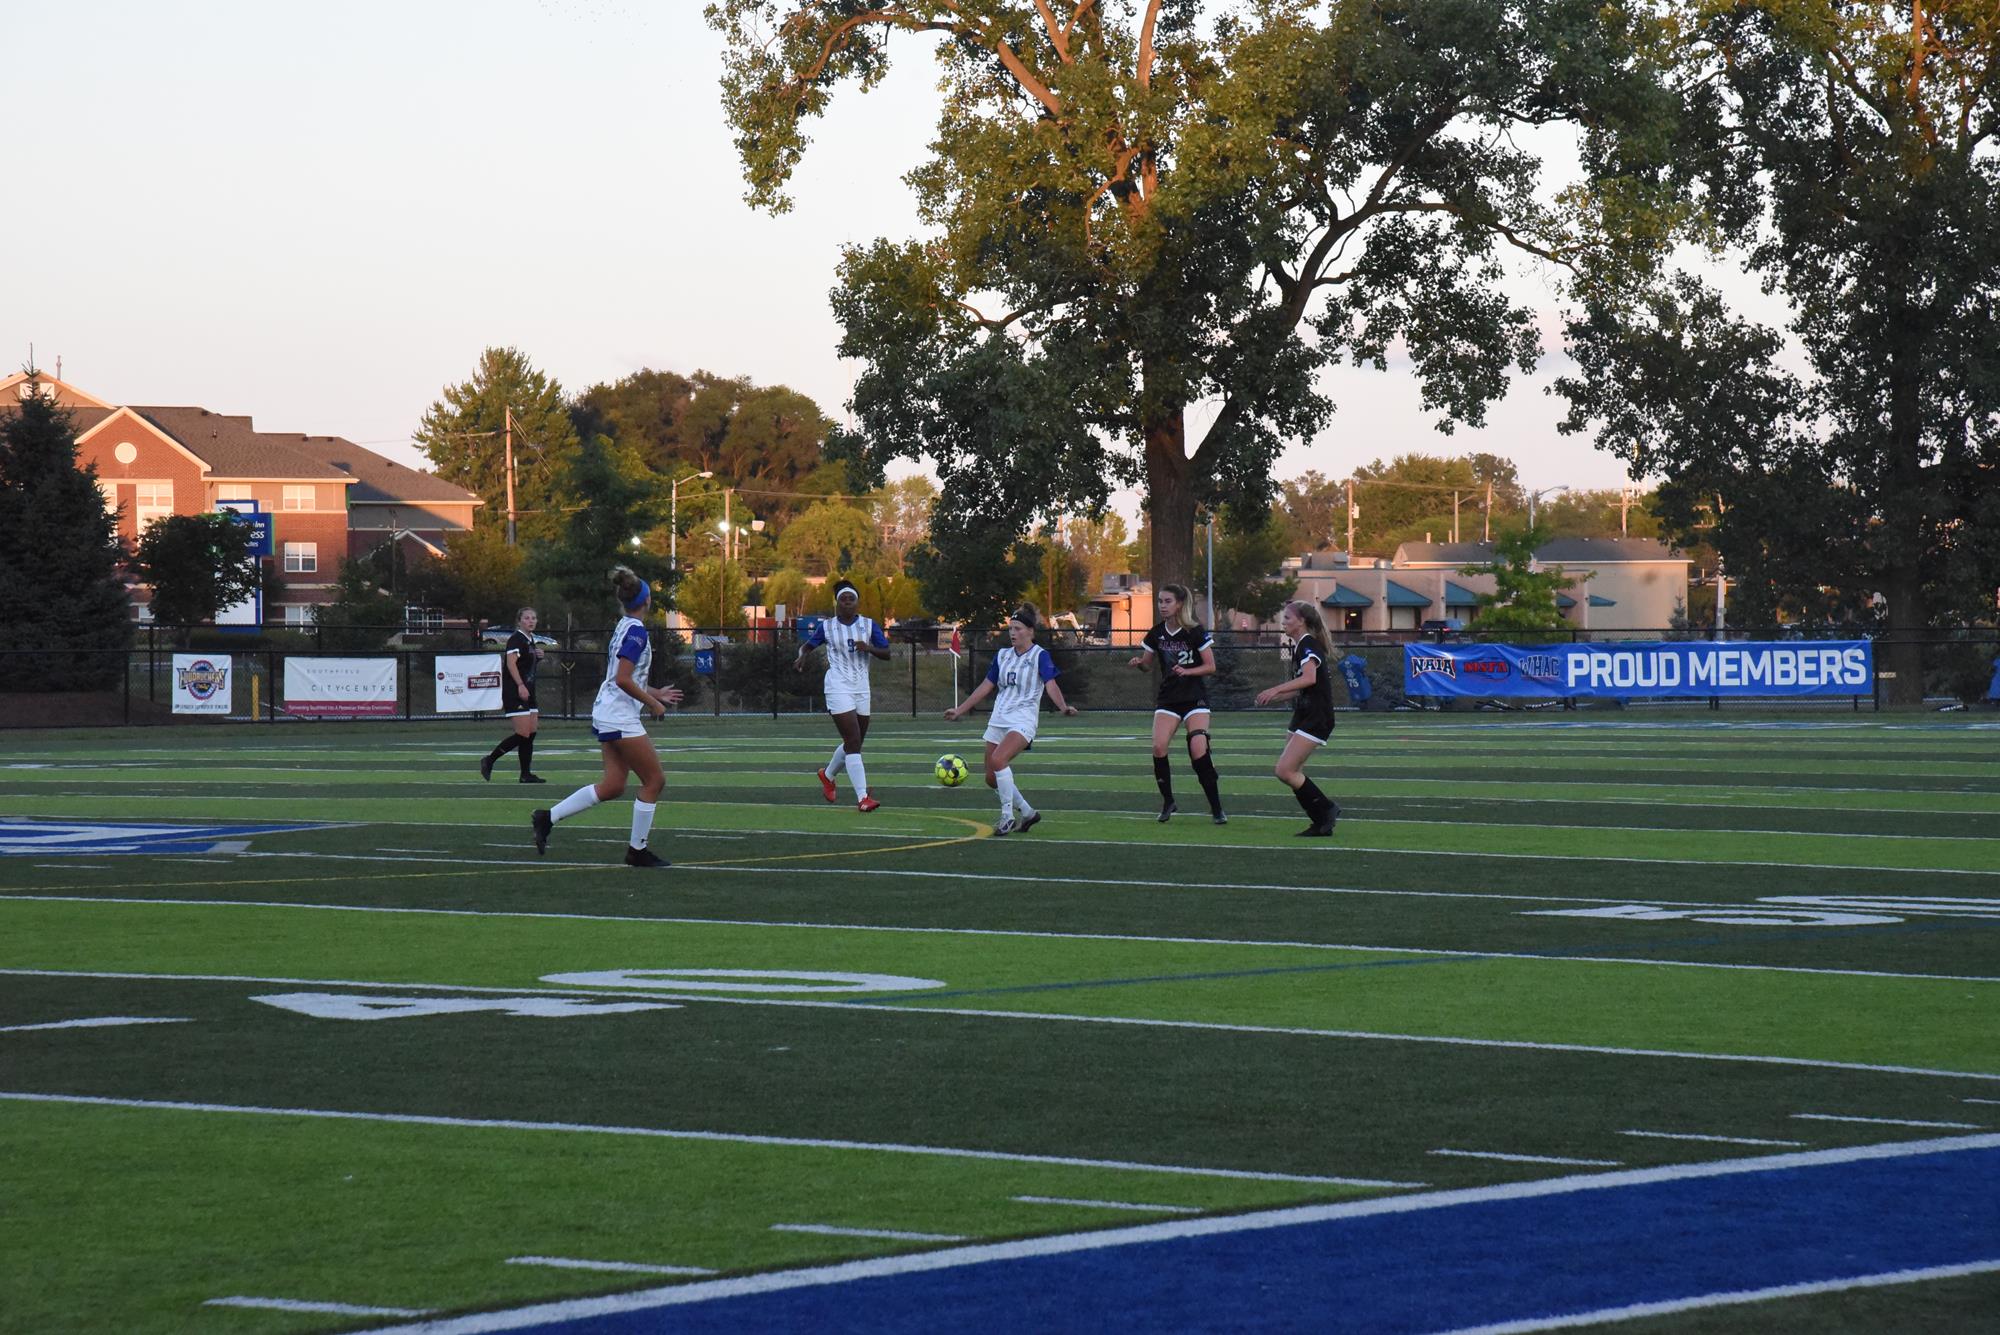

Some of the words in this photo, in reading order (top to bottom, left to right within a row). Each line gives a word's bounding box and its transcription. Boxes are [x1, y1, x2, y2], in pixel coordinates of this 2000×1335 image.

[1178, 650, 1194, 665] 21
[1411, 656, 1456, 679] NAIA
[1519, 655, 1560, 678] WHAC
[1568, 652, 1681, 688] PROUD
[1688, 648, 1867, 686] MEMBERS
